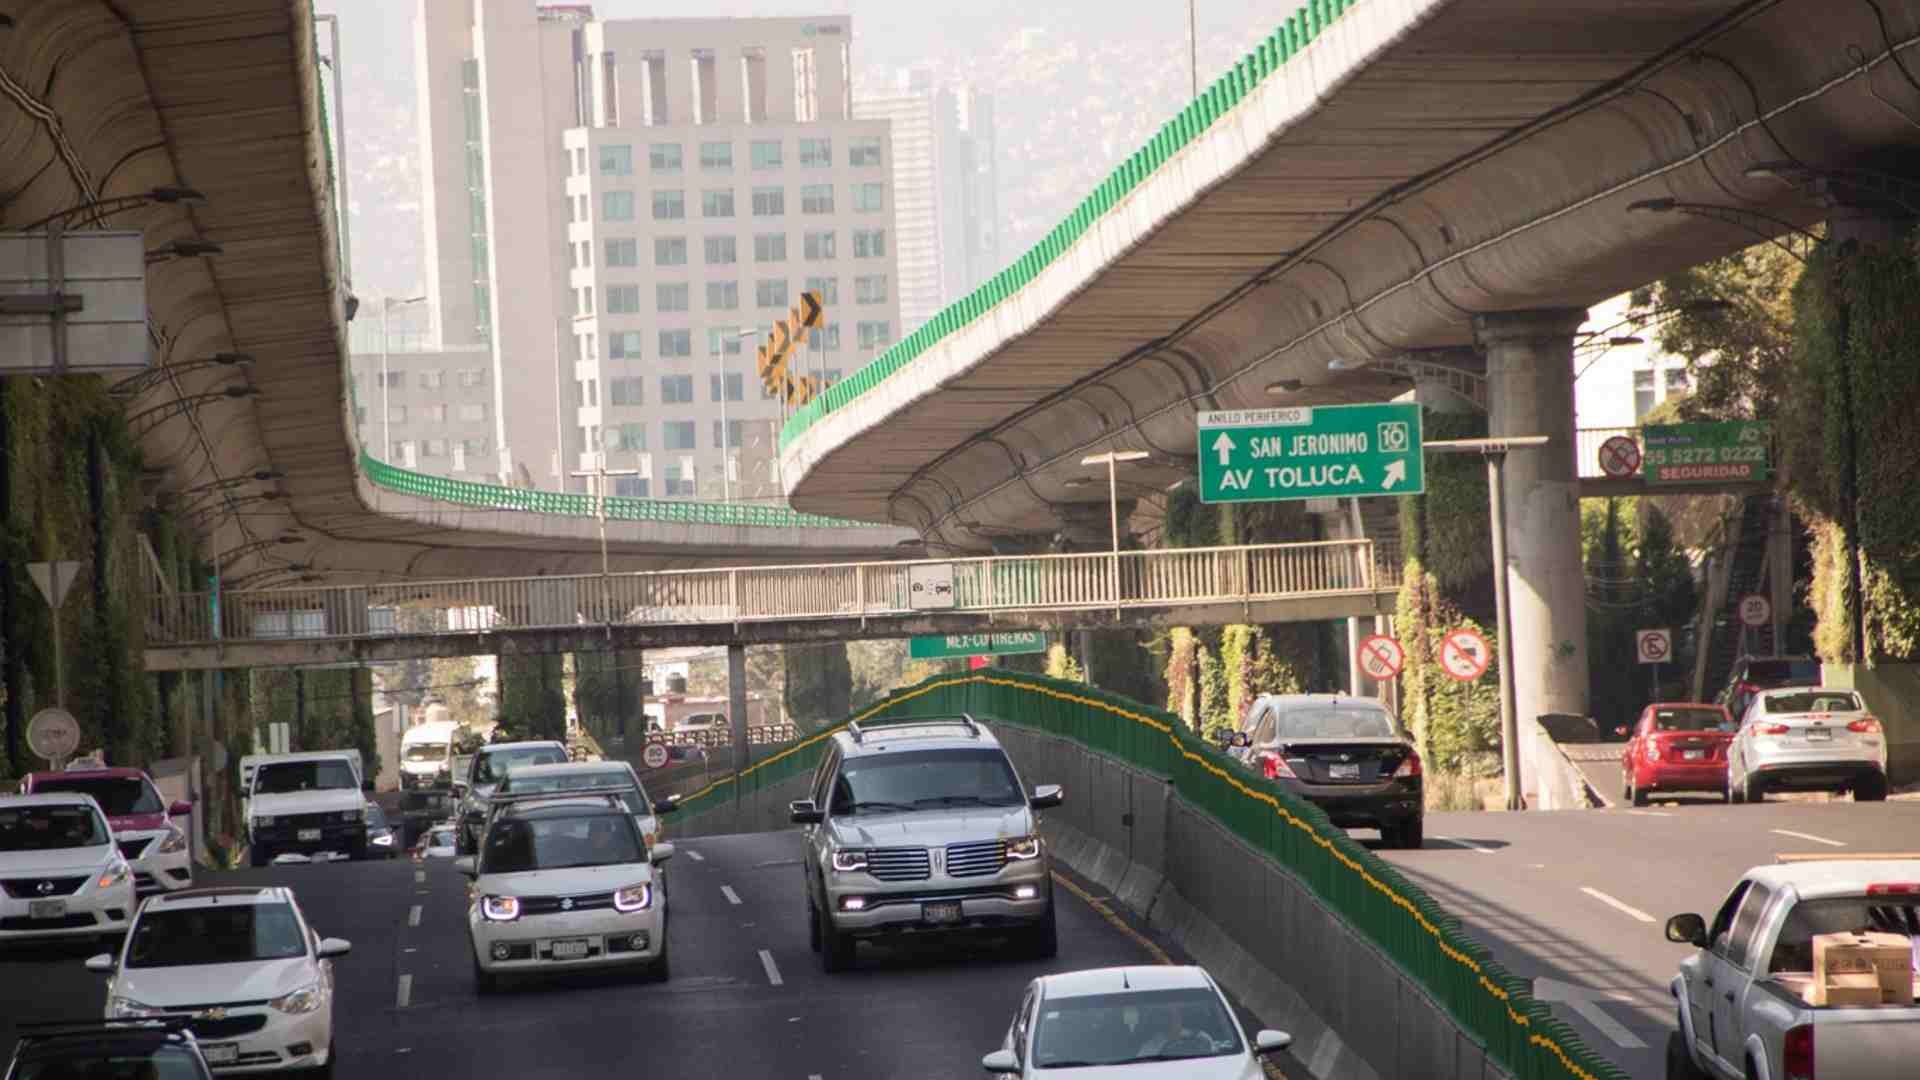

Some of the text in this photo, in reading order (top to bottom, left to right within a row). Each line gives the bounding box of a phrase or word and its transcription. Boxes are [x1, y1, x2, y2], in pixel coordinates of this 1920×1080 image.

[1207, 412, 1243, 424] ANILLO
[1250, 431, 1368, 459] SAN JERONIMO
[1672, 448, 1715, 463] 5272
[1219, 464, 1365, 491] AV TOLUCA
[1660, 464, 1750, 480] SEGURIDAD
